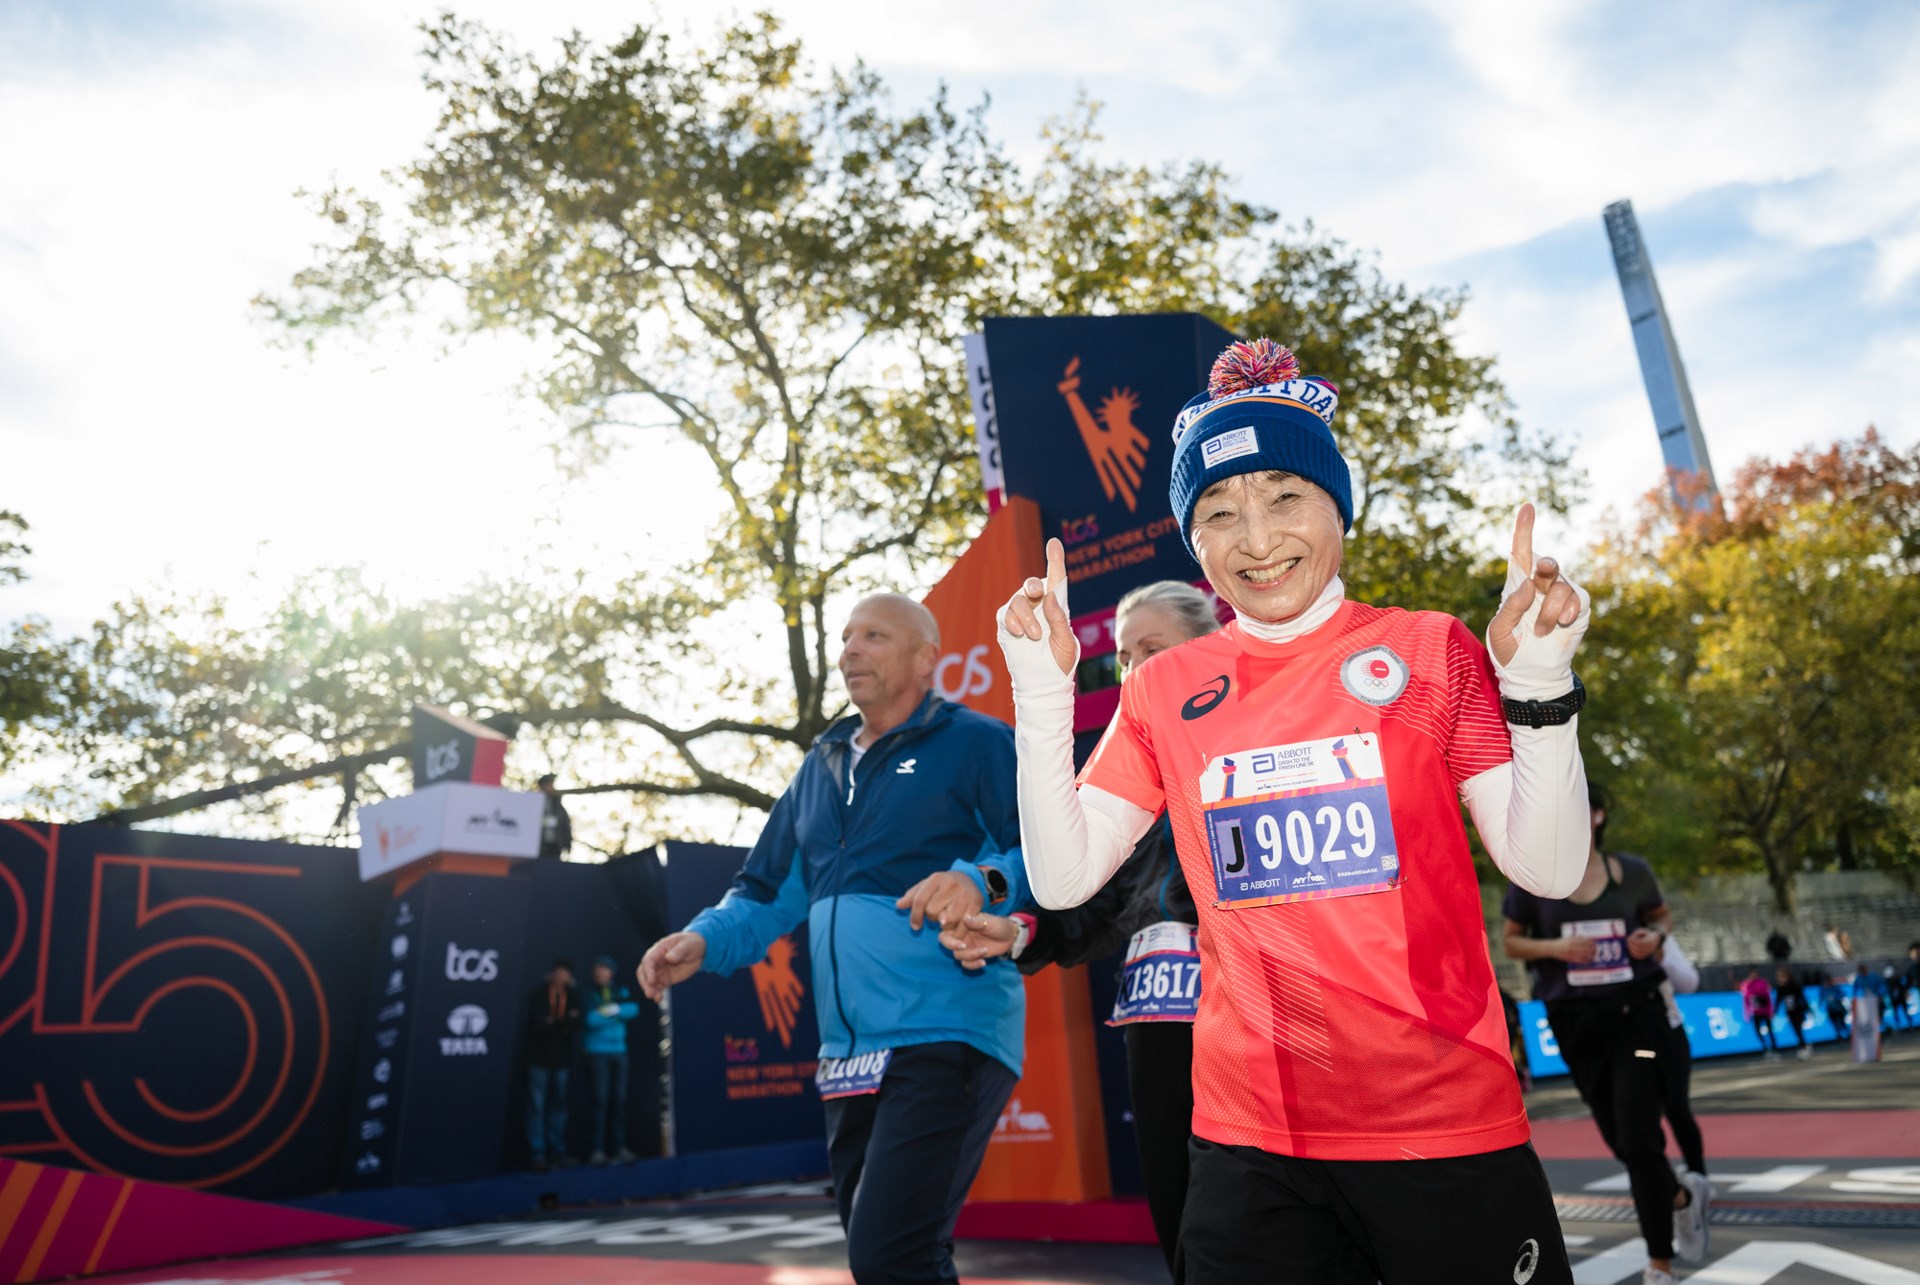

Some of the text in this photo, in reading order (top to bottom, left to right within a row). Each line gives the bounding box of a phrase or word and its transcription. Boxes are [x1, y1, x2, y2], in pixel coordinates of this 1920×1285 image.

[1066, 543, 1100, 565] NEW
[1104, 528, 1145, 550] YORK
[1068, 544, 1156, 582] MARATHON
[934, 644, 993, 702] cs
[1360, 695, 1381, 705] TOKYO
[1278, 747, 1312, 759] ABBOTT
[1278, 758, 1293, 766] DASH
[1226, 826, 1245, 873] J
[1255, 801, 1376, 870] 9029
[1250, 878, 1280, 890] ABBOTT
[445, 942, 499, 981] tcs
[1129, 961, 1201, 1002] 13617
[439, 1037, 488, 1056] TATA
